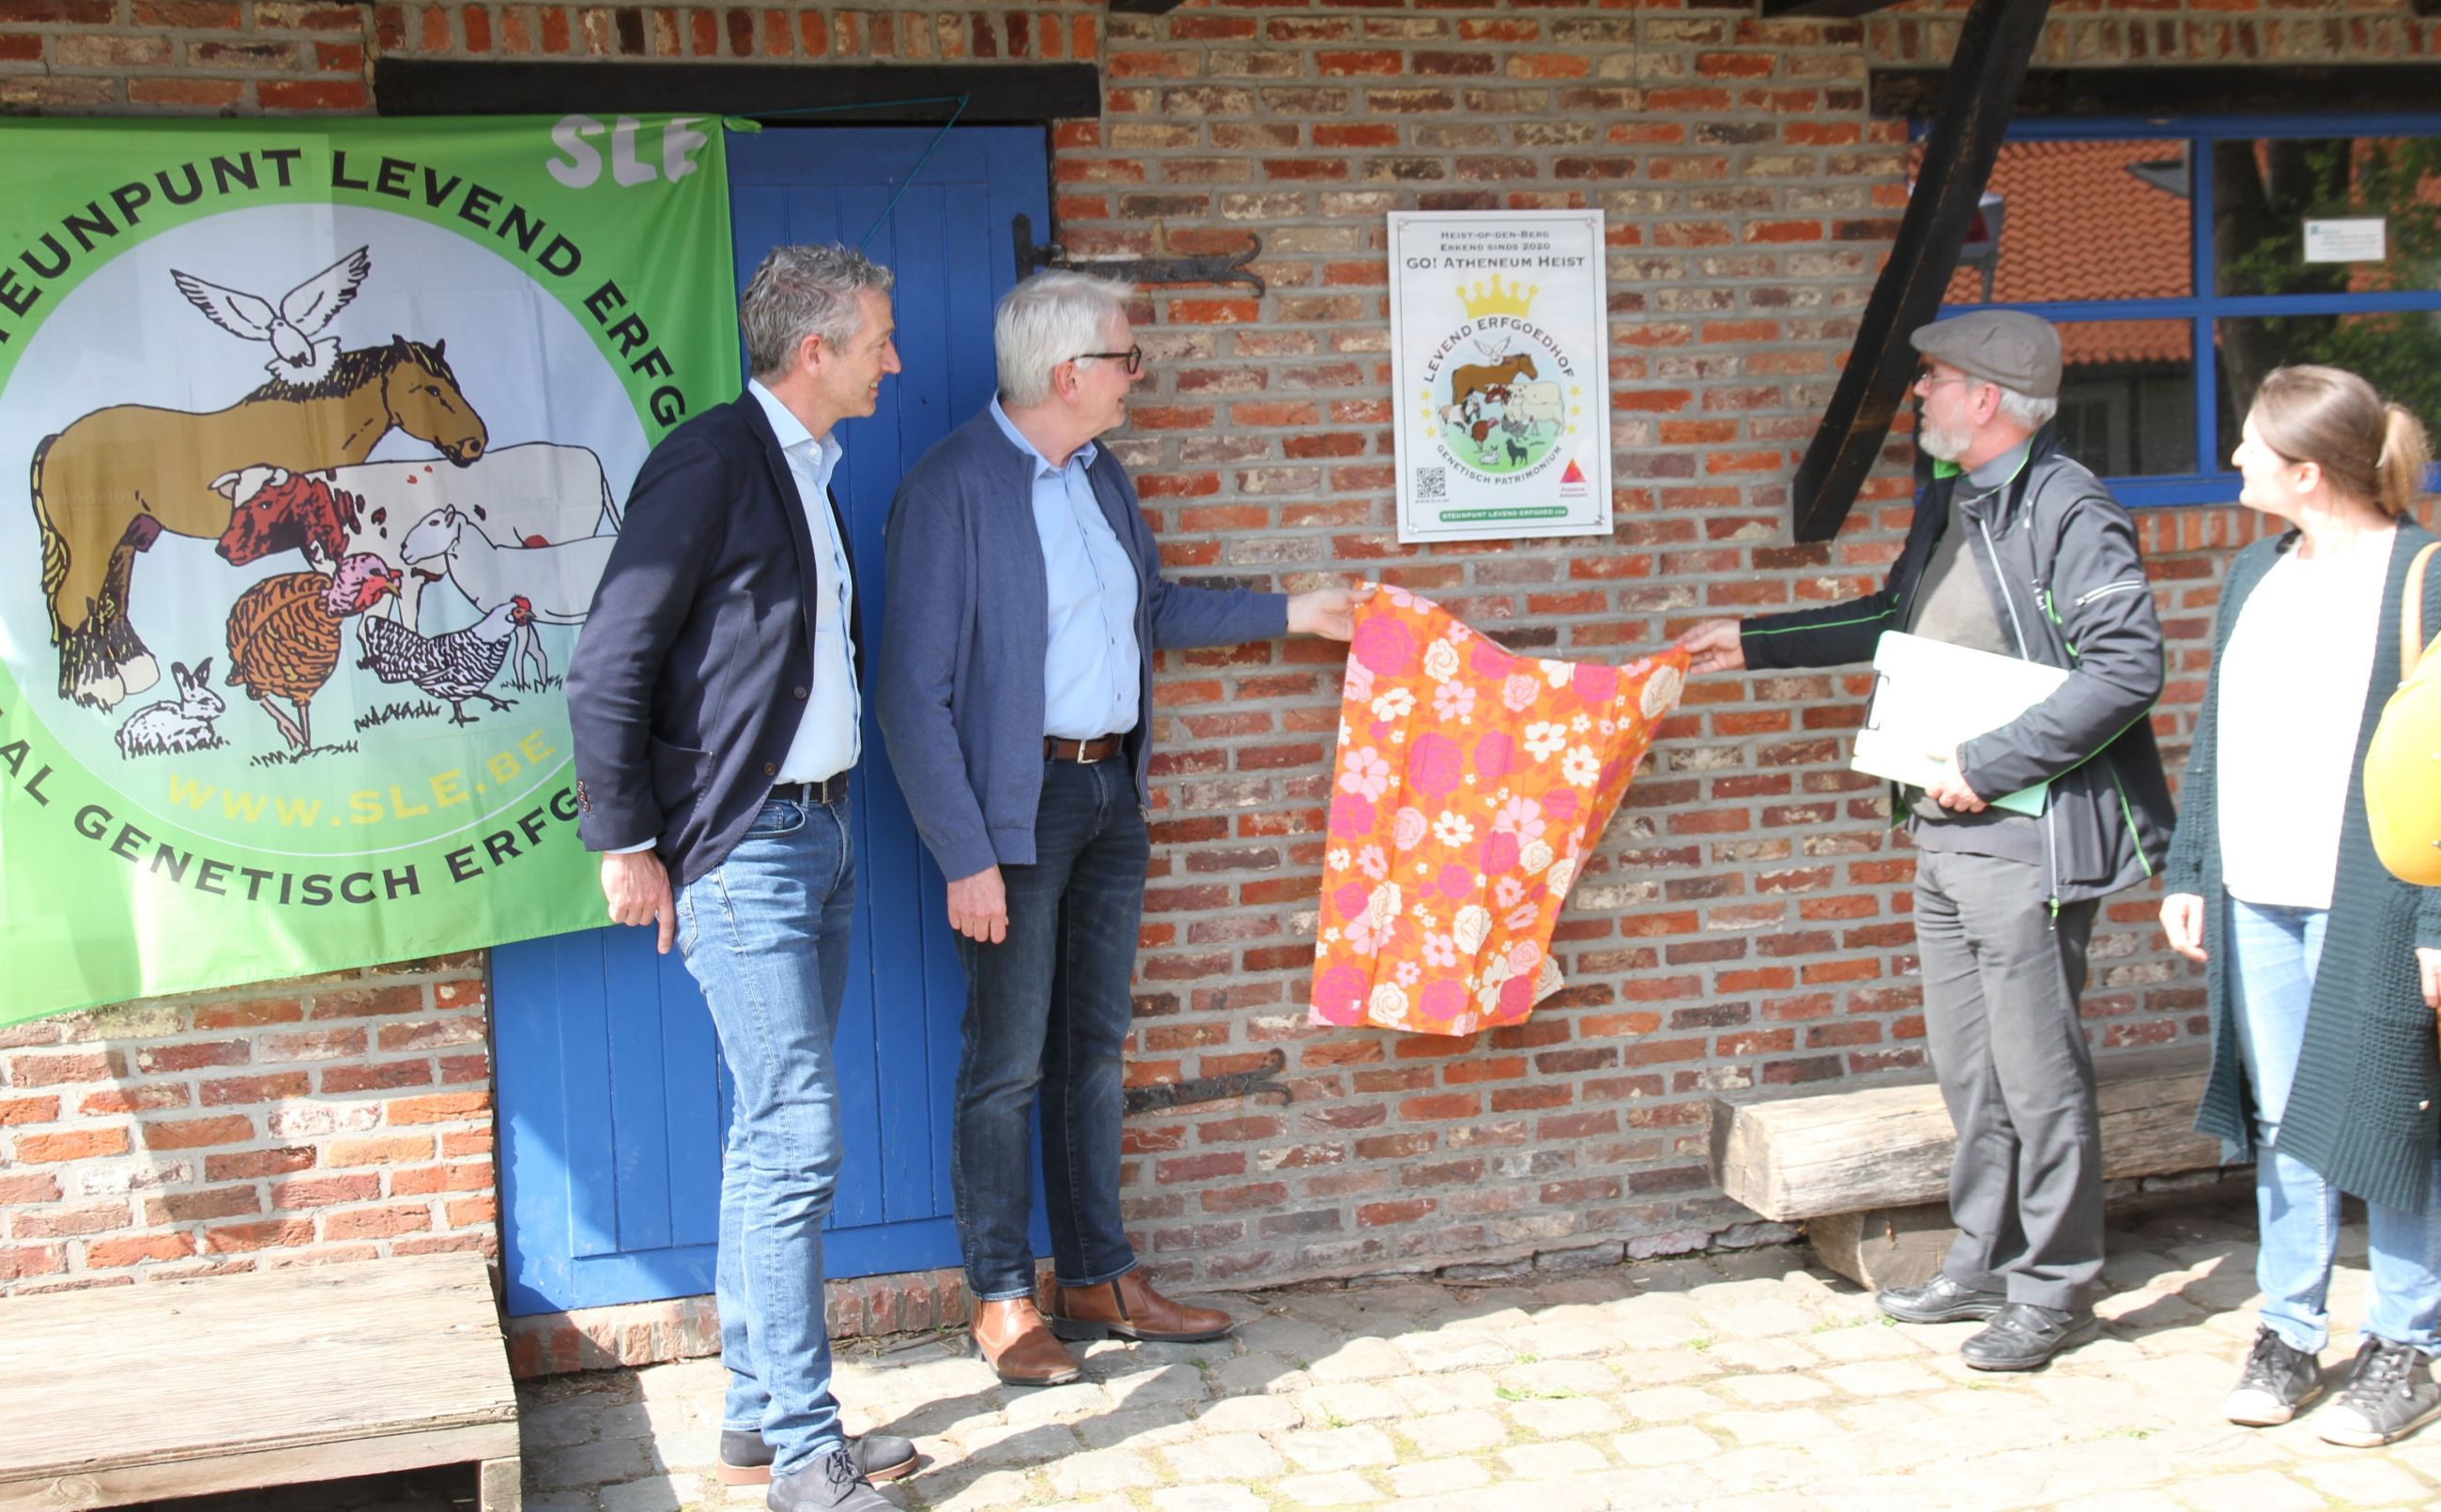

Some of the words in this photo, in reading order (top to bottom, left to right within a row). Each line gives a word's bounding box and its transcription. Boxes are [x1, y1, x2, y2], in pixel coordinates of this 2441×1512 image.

[546, 114, 708, 188] SLE
[1406, 257, 1437, 269] GO!
[1443, 256, 1532, 269] ATHENEUM
[1538, 256, 1586, 268] HEIST
[1522, 242, 1551, 251] 2020
[0, 147, 301, 344] EUNPUNT
[331, 150, 582, 277] LEVEND
[583, 279, 686, 428] ERFG
[1423, 325, 1472, 383] LEVEND
[1477, 316, 1574, 377] ERFGOEDHOF
[1436, 444, 1491, 483] GENETISCH
[1495, 445, 1562, 484] PATRIMONIUM
[0, 709, 54, 808] AL
[74, 804, 421, 906] GENETISCH
[443, 787, 579, 884] ERFG
[168, 728, 556, 828] WWW.SLE.BE
